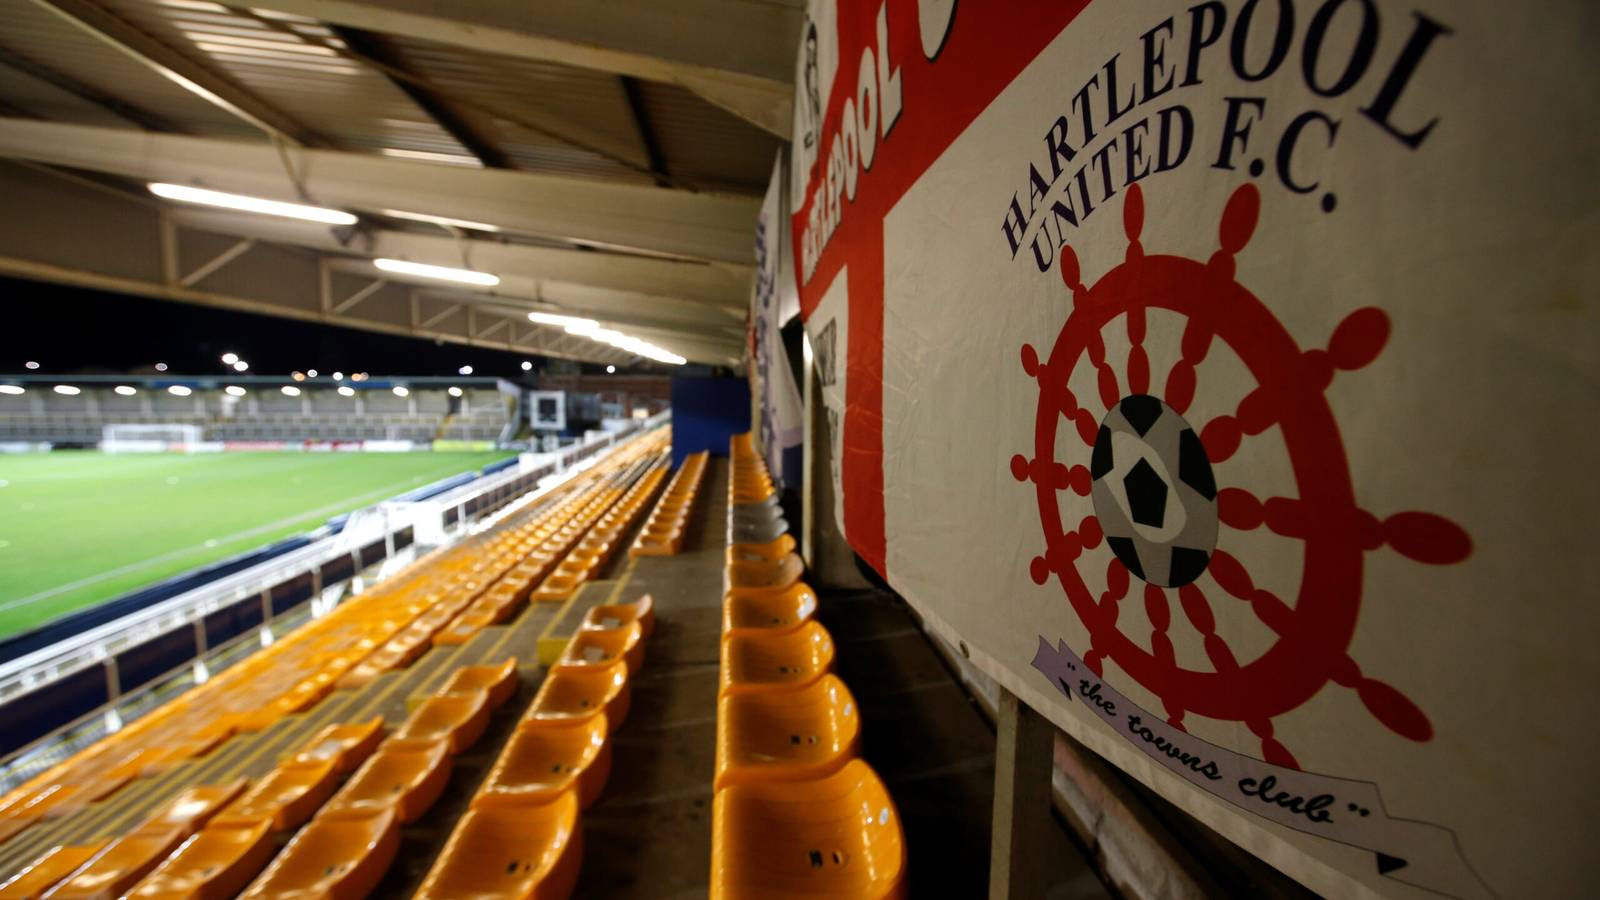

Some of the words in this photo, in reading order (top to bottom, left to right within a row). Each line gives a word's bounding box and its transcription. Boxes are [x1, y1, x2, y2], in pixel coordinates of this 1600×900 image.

[1001, 0, 1455, 261] HARTLEPOOL
[1030, 104, 1195, 273] UNITED
[1210, 97, 1341, 214] F.C.
[1128, 714, 1223, 780] towns
